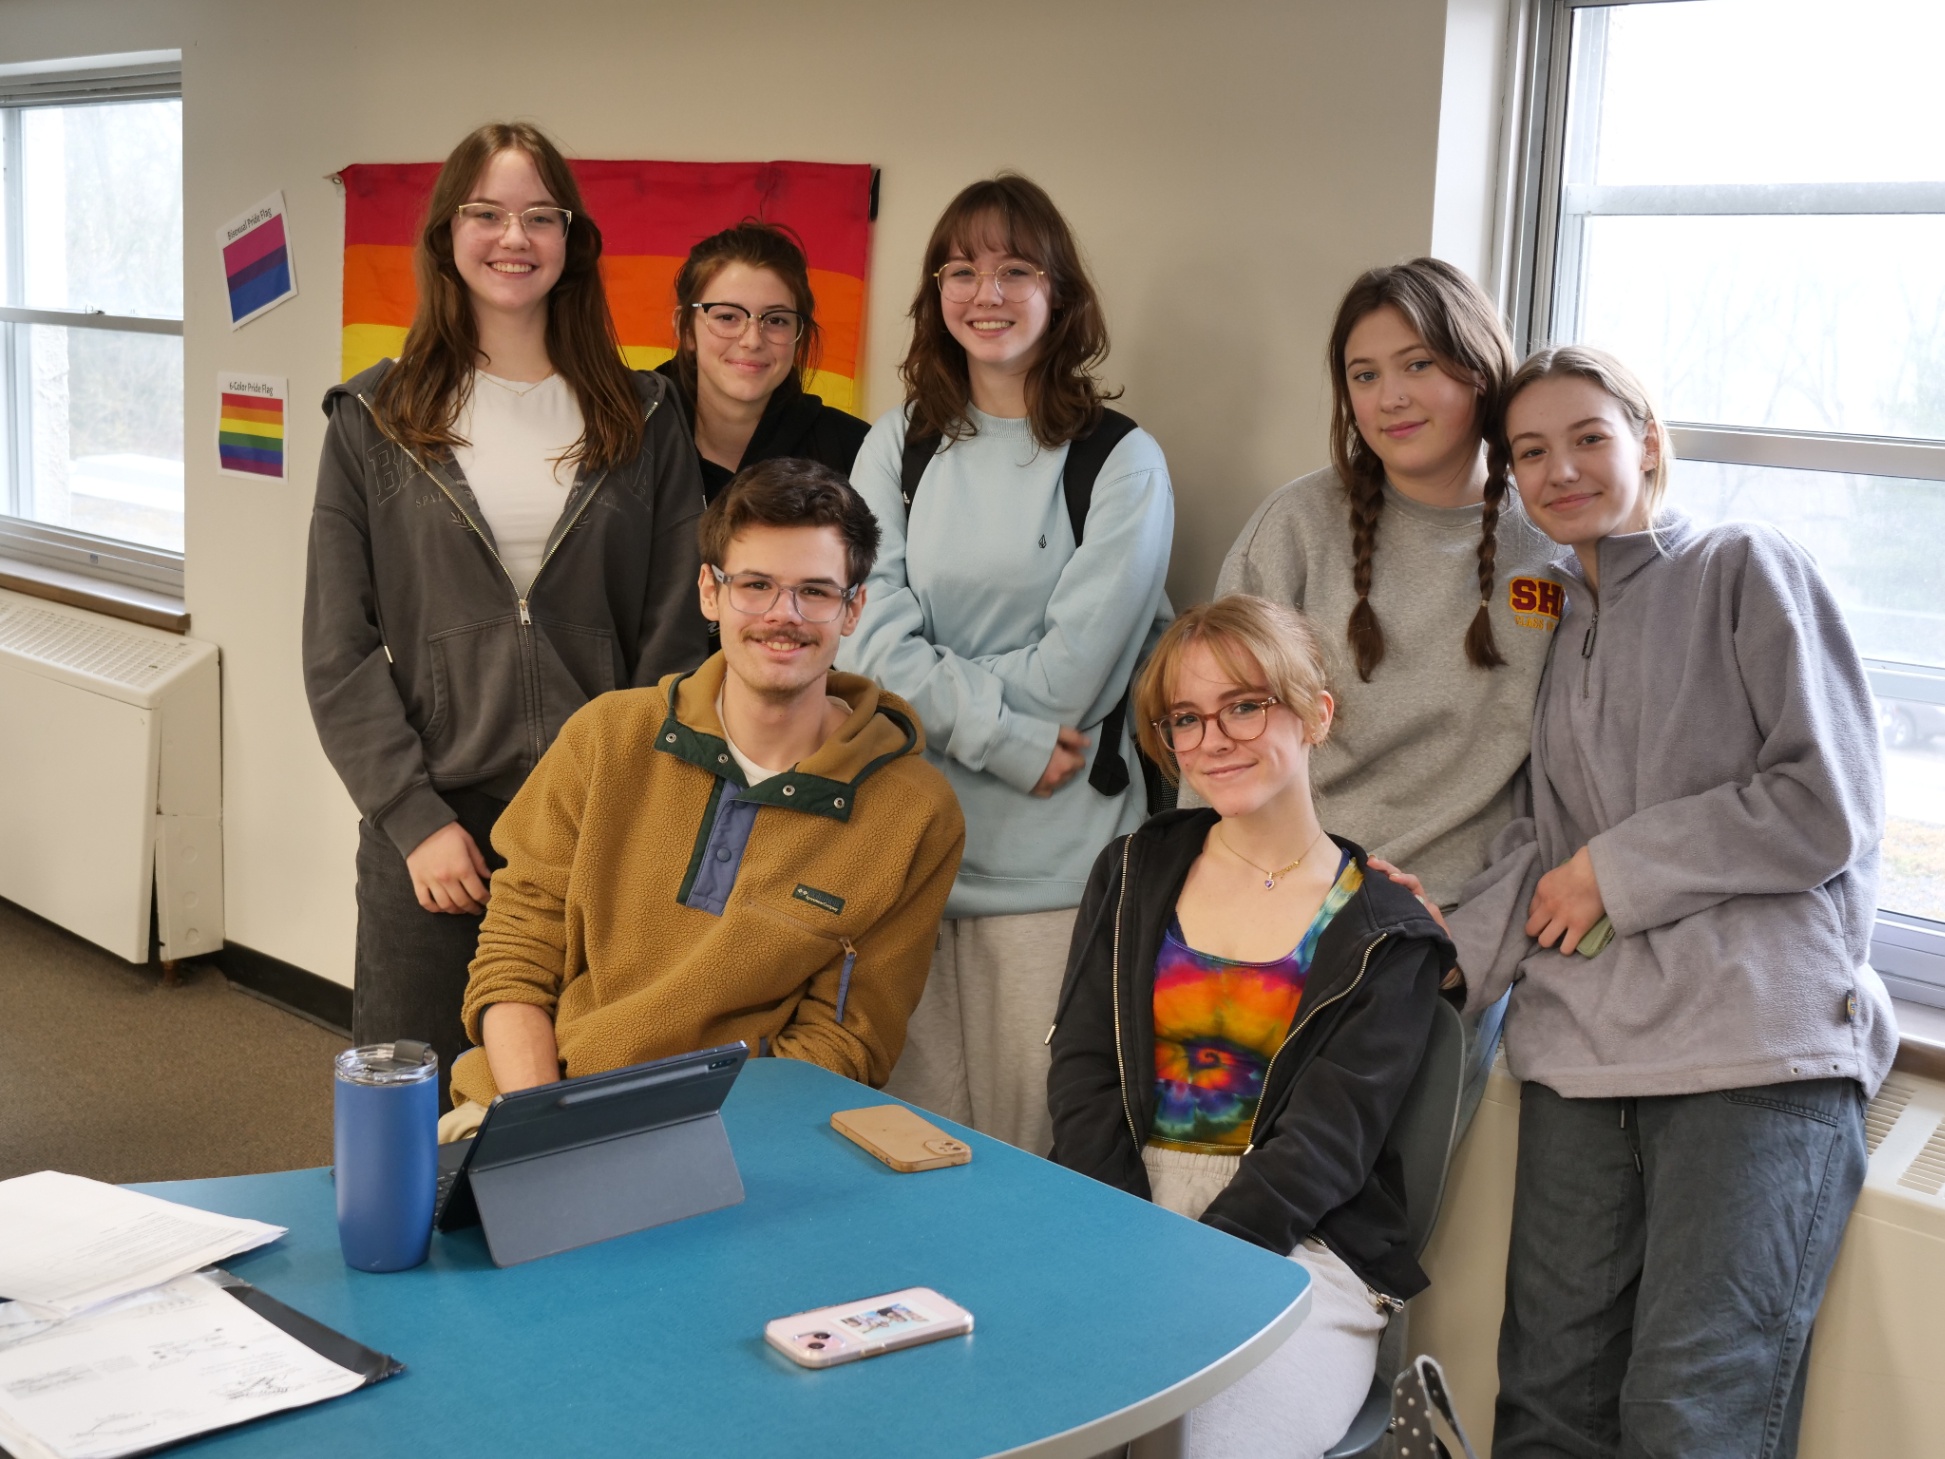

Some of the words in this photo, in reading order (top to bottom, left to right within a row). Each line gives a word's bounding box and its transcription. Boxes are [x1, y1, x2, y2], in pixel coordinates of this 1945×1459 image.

[227, 220, 247, 241] Bisexual
[247, 213, 261, 228] Pride
[260, 208, 273, 220] Flag
[247, 382, 261, 393] Pride
[261, 384, 274, 397] Flag
[1509, 576, 1566, 620] SH
[1515, 615, 1544, 631] CLASS
